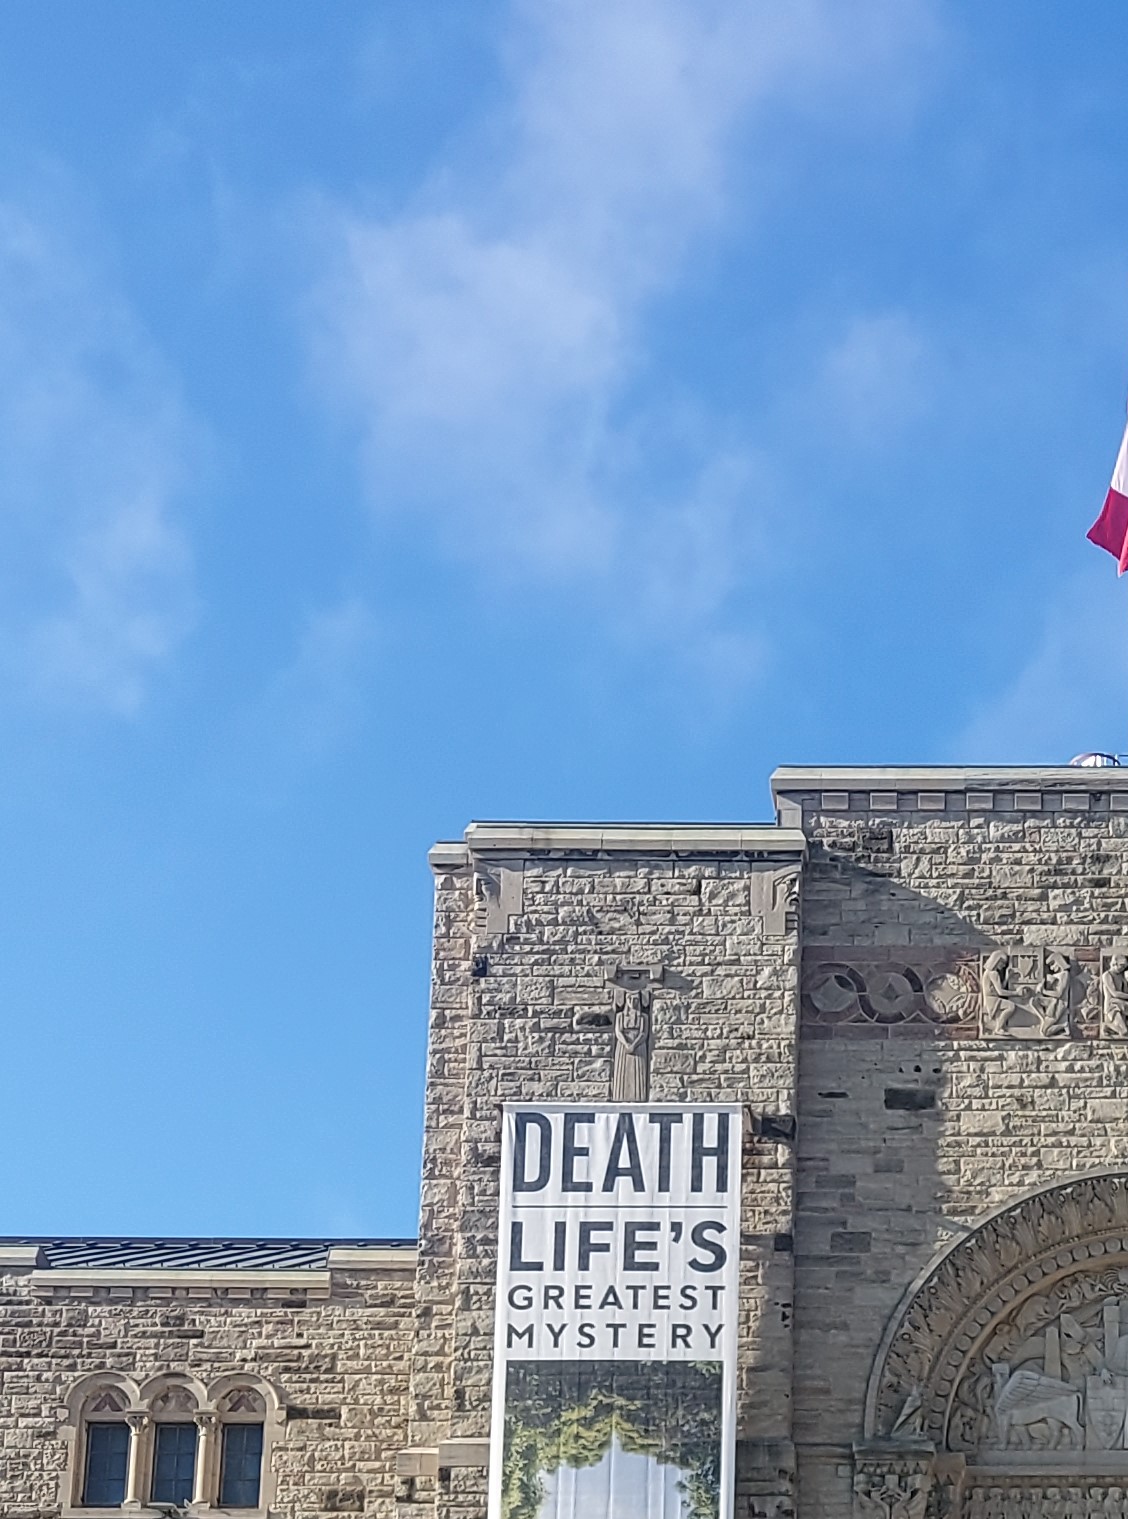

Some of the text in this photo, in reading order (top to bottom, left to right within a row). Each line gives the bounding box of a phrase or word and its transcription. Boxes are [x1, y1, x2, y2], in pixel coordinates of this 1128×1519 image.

[511, 1112, 730, 1193] DEATH
[509, 1220, 728, 1273] LIFE'S
[507, 1284, 726, 1310] GREATEST
[506, 1323, 726, 1349] MYSTERY
